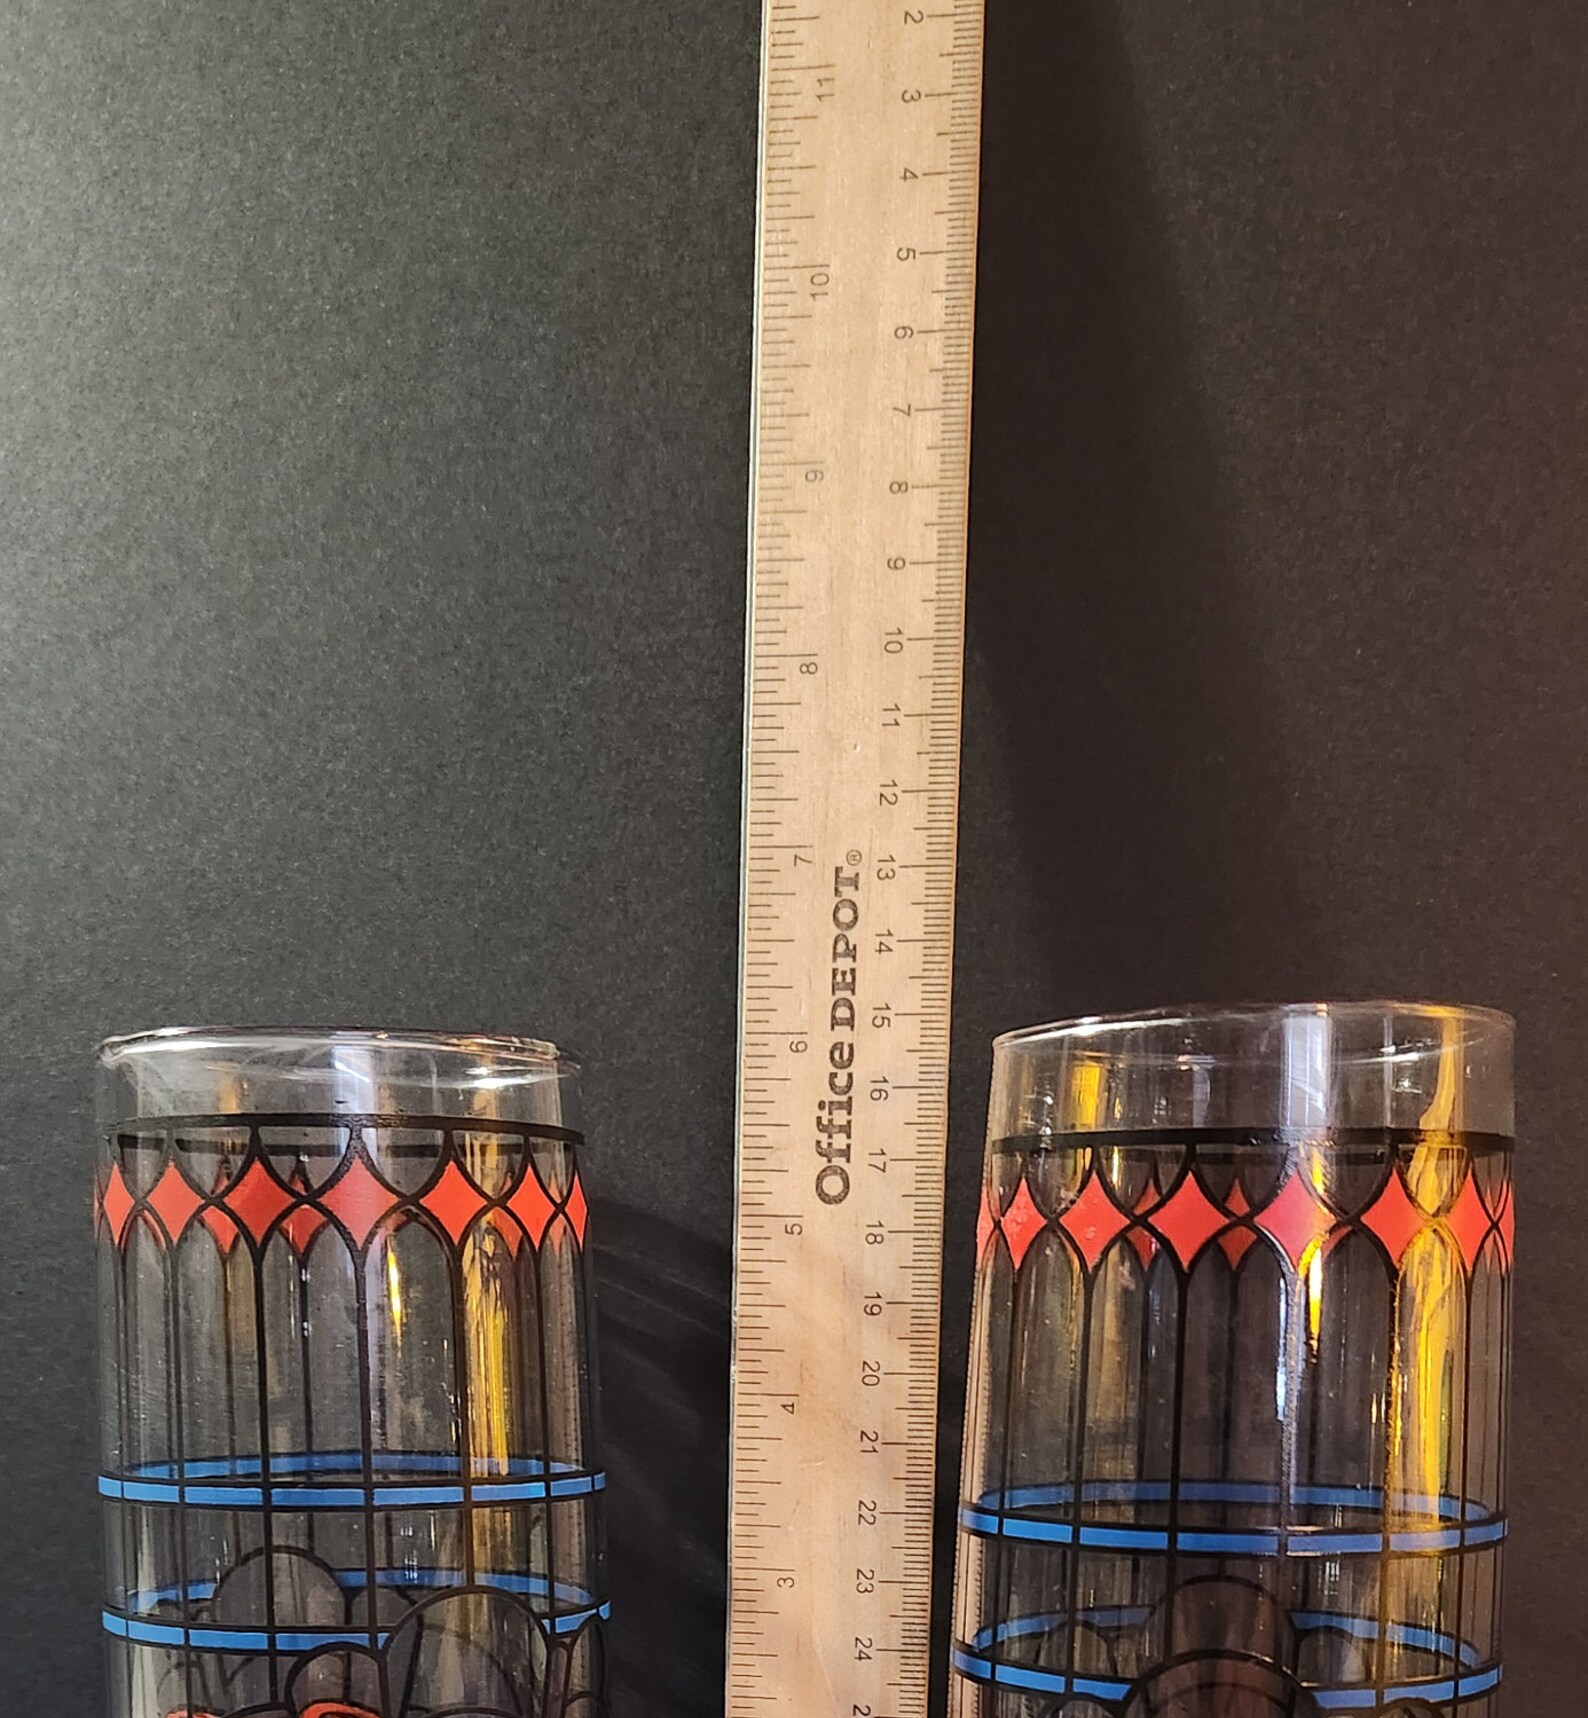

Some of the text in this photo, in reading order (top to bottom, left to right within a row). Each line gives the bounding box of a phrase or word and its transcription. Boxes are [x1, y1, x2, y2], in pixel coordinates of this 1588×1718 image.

[903, 10, 924, 25] 2
[815, 77, 836, 103] 11
[901, 89, 922, 104] 3
[899, 167, 919, 182] 4
[896, 247, 917, 262] 5
[809, 272, 830, 301] 10
[893, 325, 915, 340] 6
[892, 403, 912, 417] 7
[804, 469, 825, 483] 9
[888, 481, 909, 495] 8
[886, 556, 907, 571] 9
[883, 627, 904, 654] 10
[798, 661, 819, 676] 8
[881, 703, 902, 727] 11
[879, 779, 899, 806] 12
[793, 853, 813, 867] 7
[876, 854, 896, 881] 13
[874, 928, 894, 955] 14
[871, 1002, 892, 1029] 15
[788, 1040, 808, 1054] 6
[869, 1075, 890, 1102] 16
[815, 1041, 855, 1205] Office
[867, 1147, 887, 1174] 17
[784, 1223, 803, 1236] 5
[864, 1220, 885, 1246] 18
[863, 1291, 883, 1317] 19
[861, 1360, 881, 1387] 20
[779, 1401, 796, 1416] 4
[859, 1429, 879, 1454] 21
[857, 1499, 878, 1526] 22
[776, 1576, 795, 1589] 3
[855, 1568, 875, 1594] 23
[854, 1636, 873, 1662] 24
